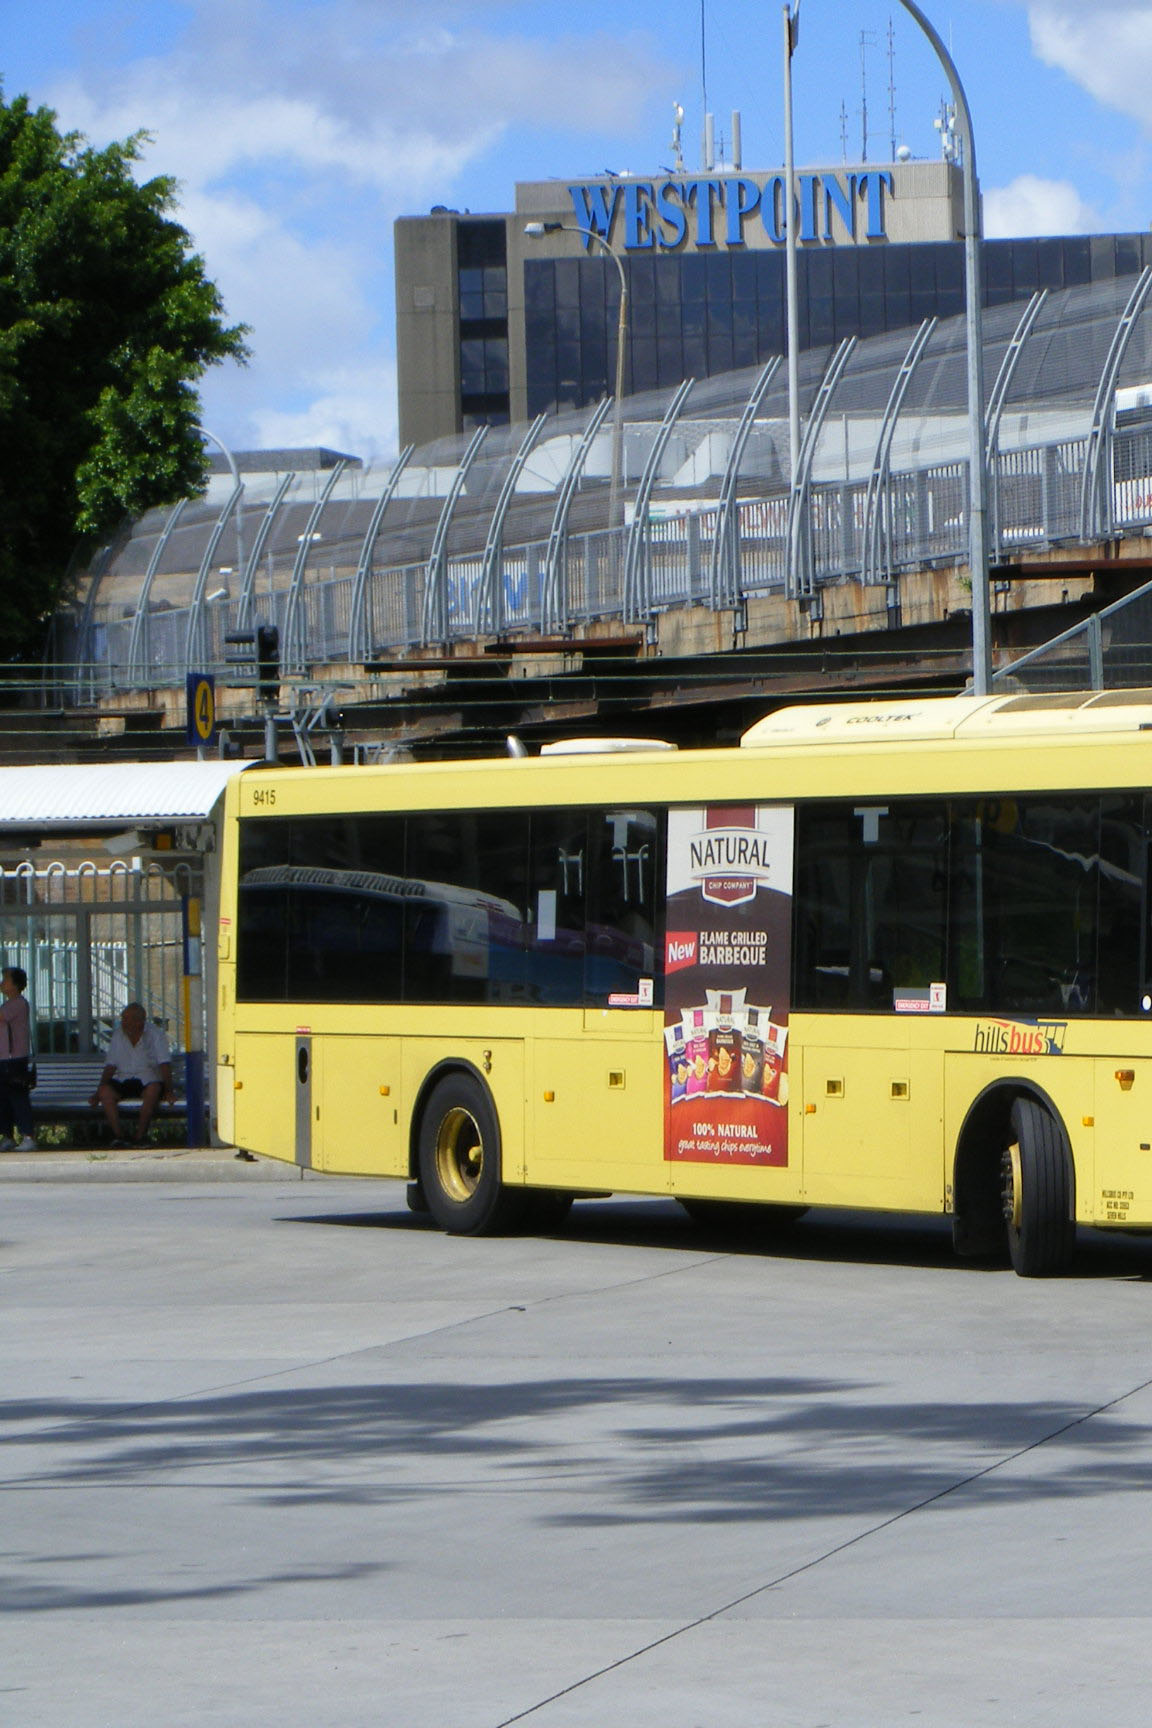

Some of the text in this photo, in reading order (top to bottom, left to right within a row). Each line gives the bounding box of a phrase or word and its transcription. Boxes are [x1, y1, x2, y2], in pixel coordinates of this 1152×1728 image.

[568, 171, 892, 250] WESTPOINT
[199, 686, 209, 731] 4
[253, 789, 276, 806] 9415
[690, 836, 770, 869] NATURAL
[709, 881, 722, 890] CHIP
[700, 931, 767, 946] FLAME GRILLED
[668, 941, 696, 964] New
[700, 946, 766, 966] BARBEQUE
[974, 1023, 1044, 1055] hillsbus
[692, 1122, 758, 1139] 100% NATURAL
[721, 1139, 738, 1156] chips
